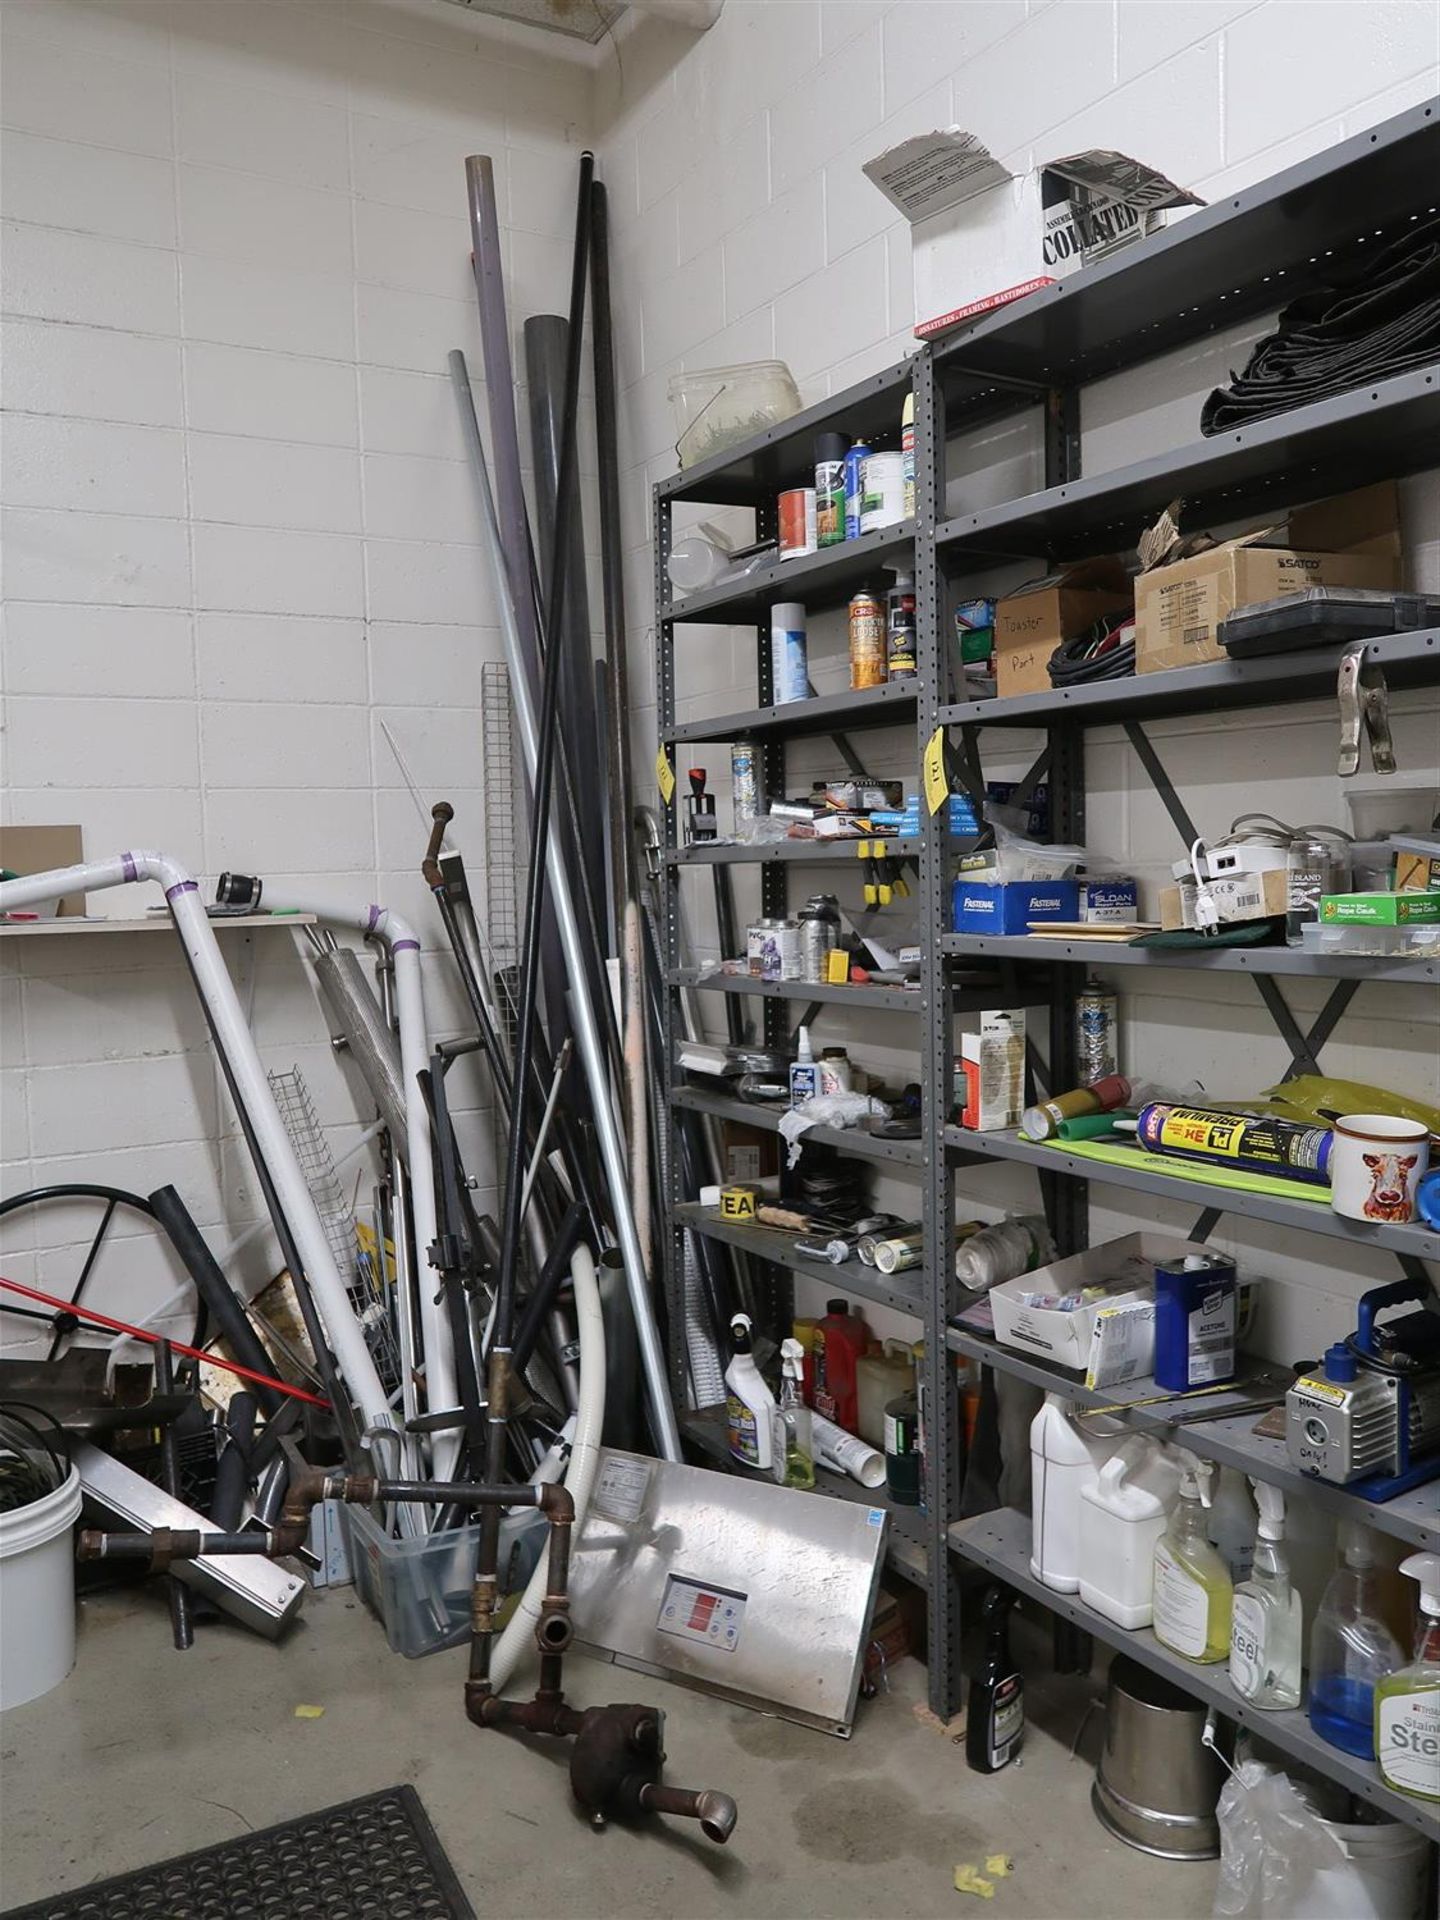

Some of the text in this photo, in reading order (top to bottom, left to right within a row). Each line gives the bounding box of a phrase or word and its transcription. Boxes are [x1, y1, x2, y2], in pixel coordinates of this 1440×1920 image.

[1042, 202, 1139, 266] COLLATED
[1285, 559, 1320, 569] SATCO
[1012, 653, 1034, 672] Part
[964, 898, 994, 909] FASTENAL
[1030, 898, 1061, 908] FASTENAL
[1172, 1109, 1245, 1127] PREMIUM
[721, 1194, 757, 1215] EA
[1199, 1321, 1226, 1332] ACETONE
[1230, 1627, 1260, 1665] teel
